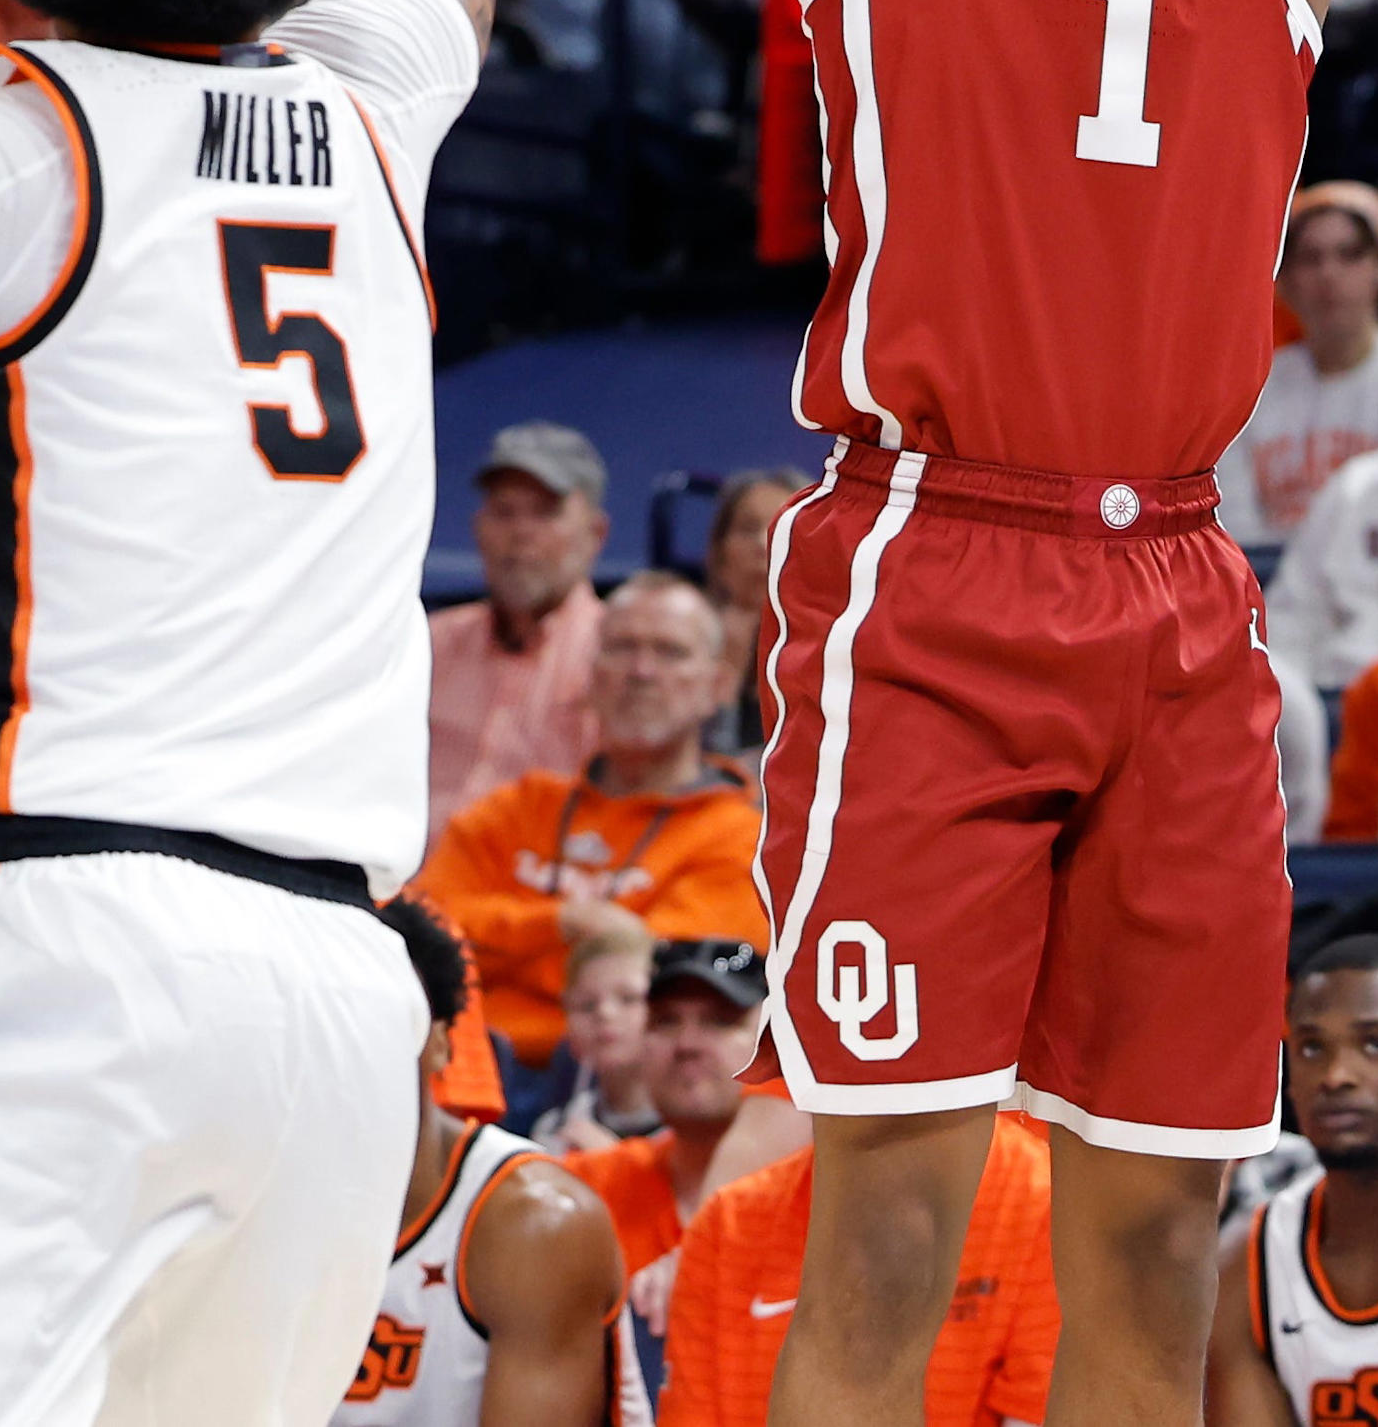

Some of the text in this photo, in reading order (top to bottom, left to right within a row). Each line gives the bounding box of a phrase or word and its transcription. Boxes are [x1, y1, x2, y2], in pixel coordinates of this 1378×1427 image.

[196, 89, 333, 187] MILLER
[215, 217, 369, 484] 5
[816, 920, 920, 1062] OU
